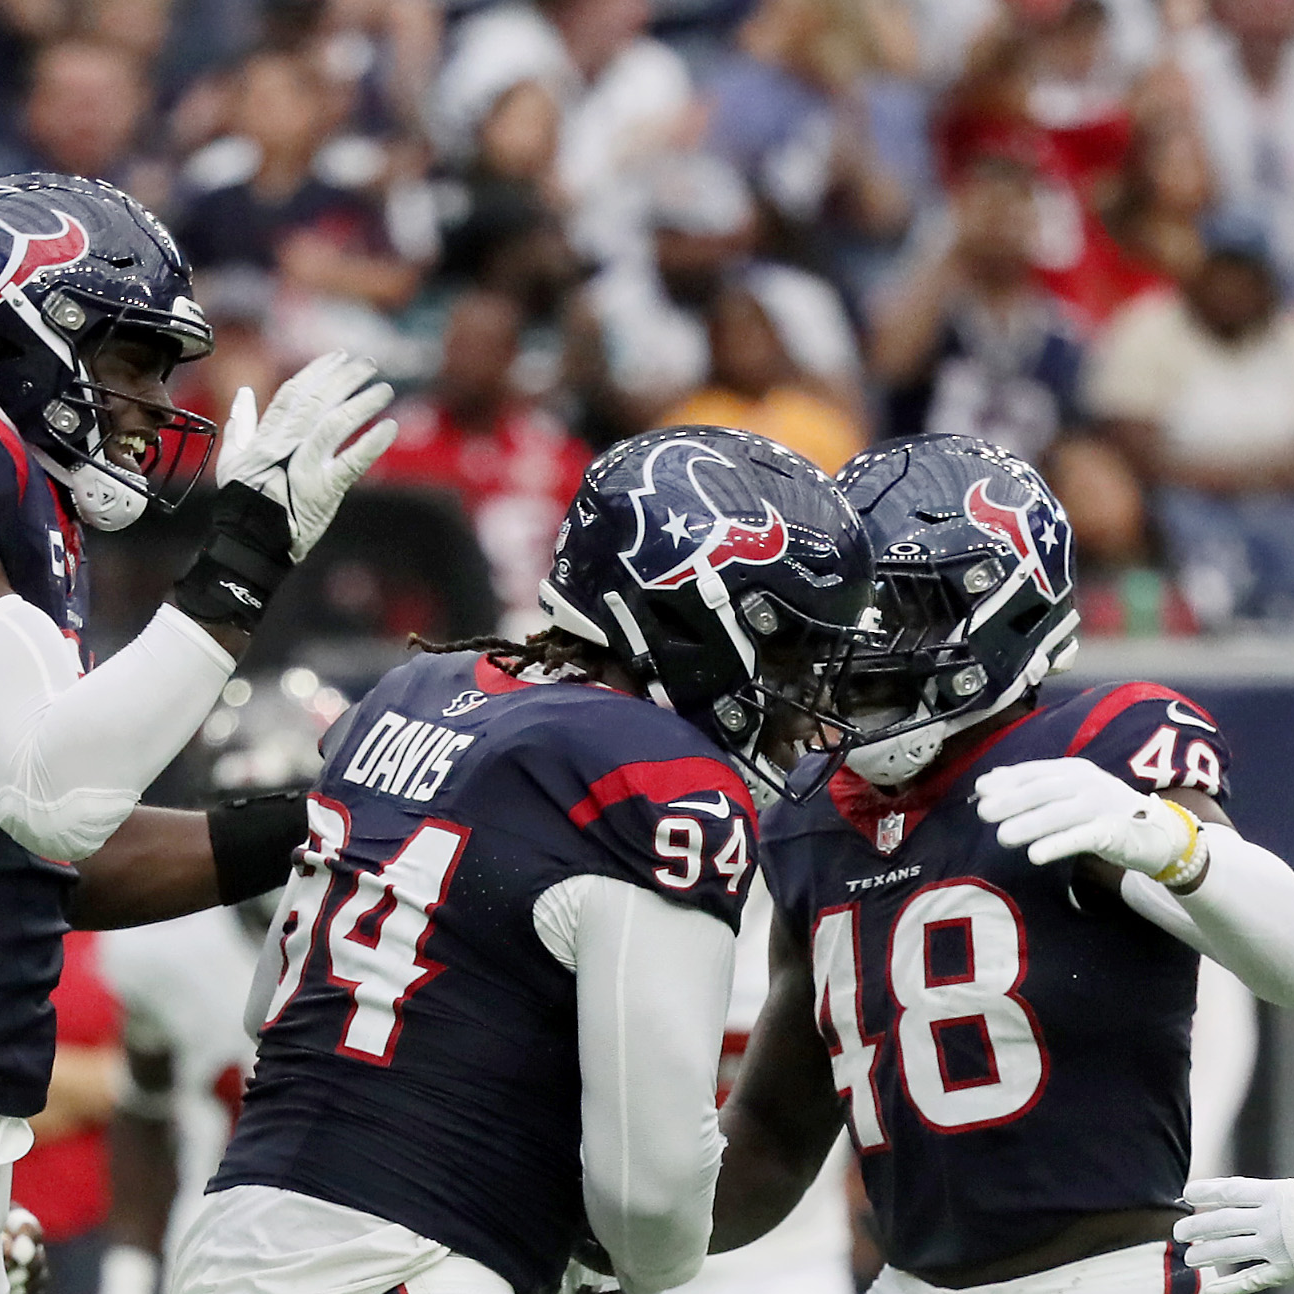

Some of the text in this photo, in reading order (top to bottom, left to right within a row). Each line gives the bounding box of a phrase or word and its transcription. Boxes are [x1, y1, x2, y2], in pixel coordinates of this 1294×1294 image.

[48, 529, 66, 578] C
[343, 710, 475, 802] DAVIS
[1127, 723, 1222, 796] 48
[652, 814, 751, 896] 94
[845, 863, 923, 893] TEXANS
[251, 791, 473, 1068] 94
[812, 876, 1051, 1154] 48
